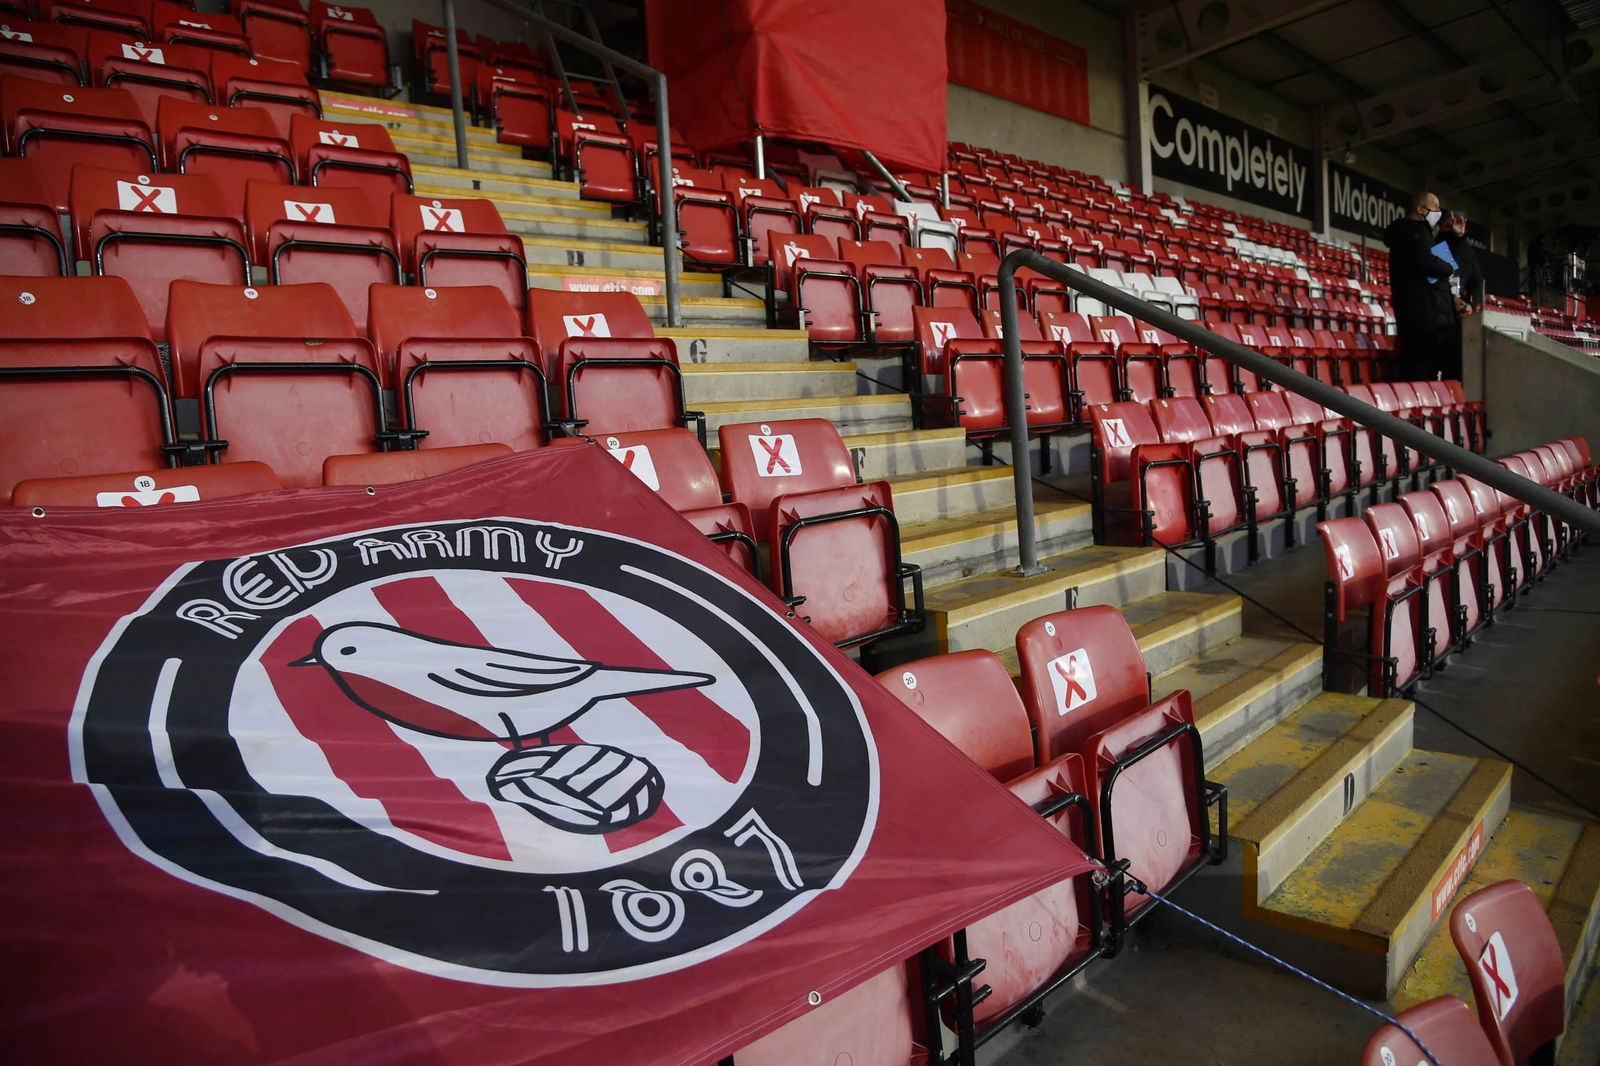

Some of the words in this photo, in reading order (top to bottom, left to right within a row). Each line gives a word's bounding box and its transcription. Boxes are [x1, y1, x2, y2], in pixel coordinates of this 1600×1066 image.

[1149, 94, 1306, 213] Completely
[689, 338, 707, 364] G
[139, 480, 151, 488] 18
[176, 548, 338, 641] RED
[353, 526, 584, 570] ARMY
[1342, 772, 1355, 817] D
